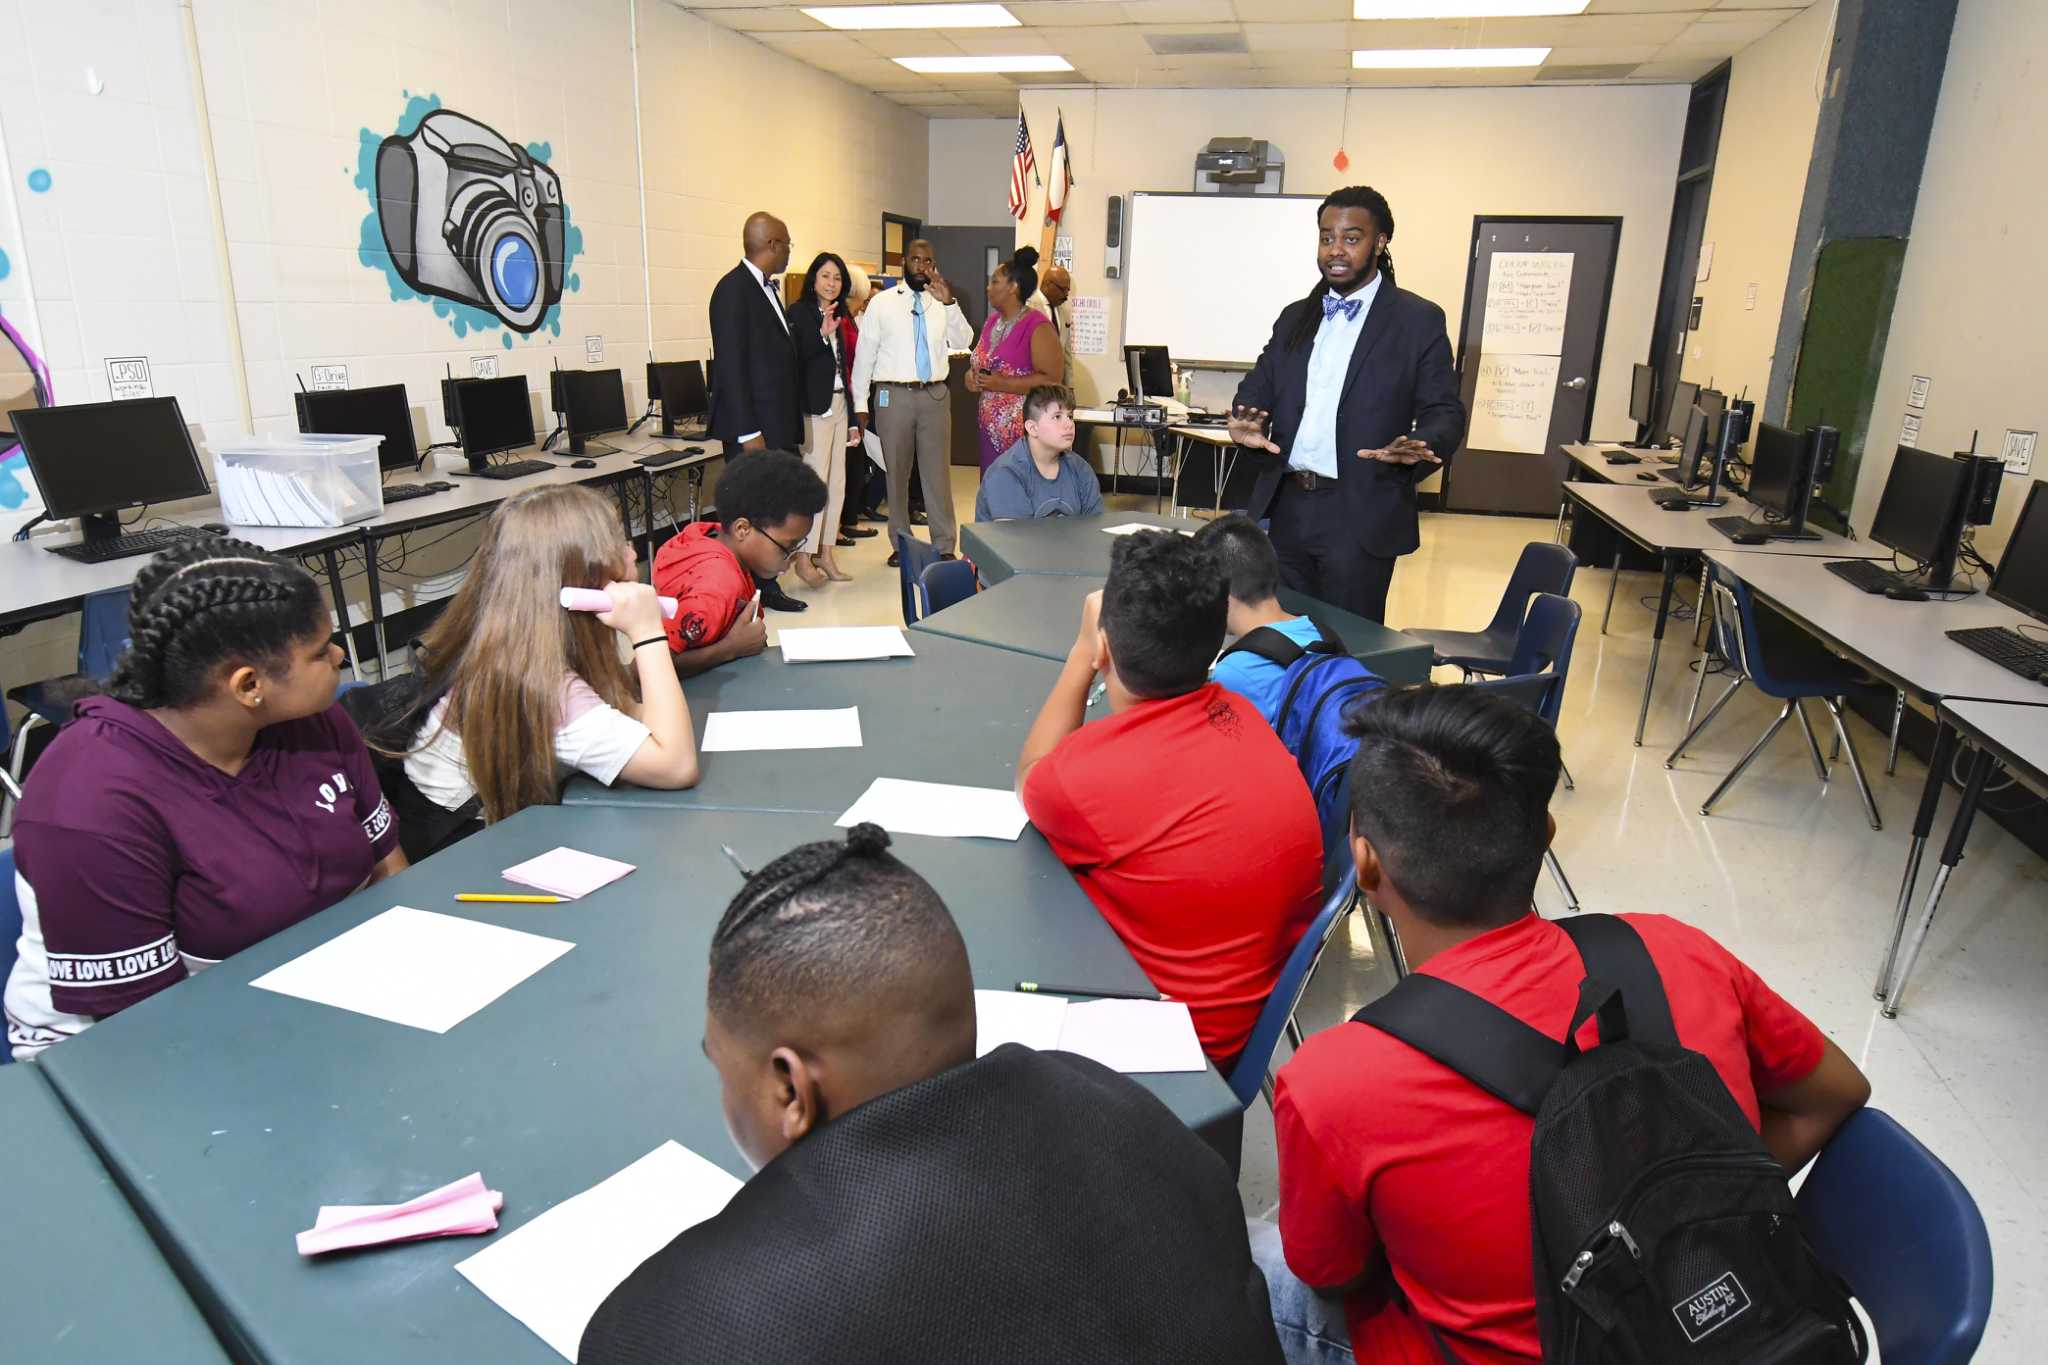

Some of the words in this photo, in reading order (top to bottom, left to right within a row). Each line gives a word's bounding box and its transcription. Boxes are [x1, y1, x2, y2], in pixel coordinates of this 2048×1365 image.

[315, 773, 353, 813] LOV
[49, 960, 74, 980] OVE
[76, 961, 114, 980] LOVE
[116, 951, 158, 976] LOVE
[1688, 1282, 1730, 1317] AUSTIN
